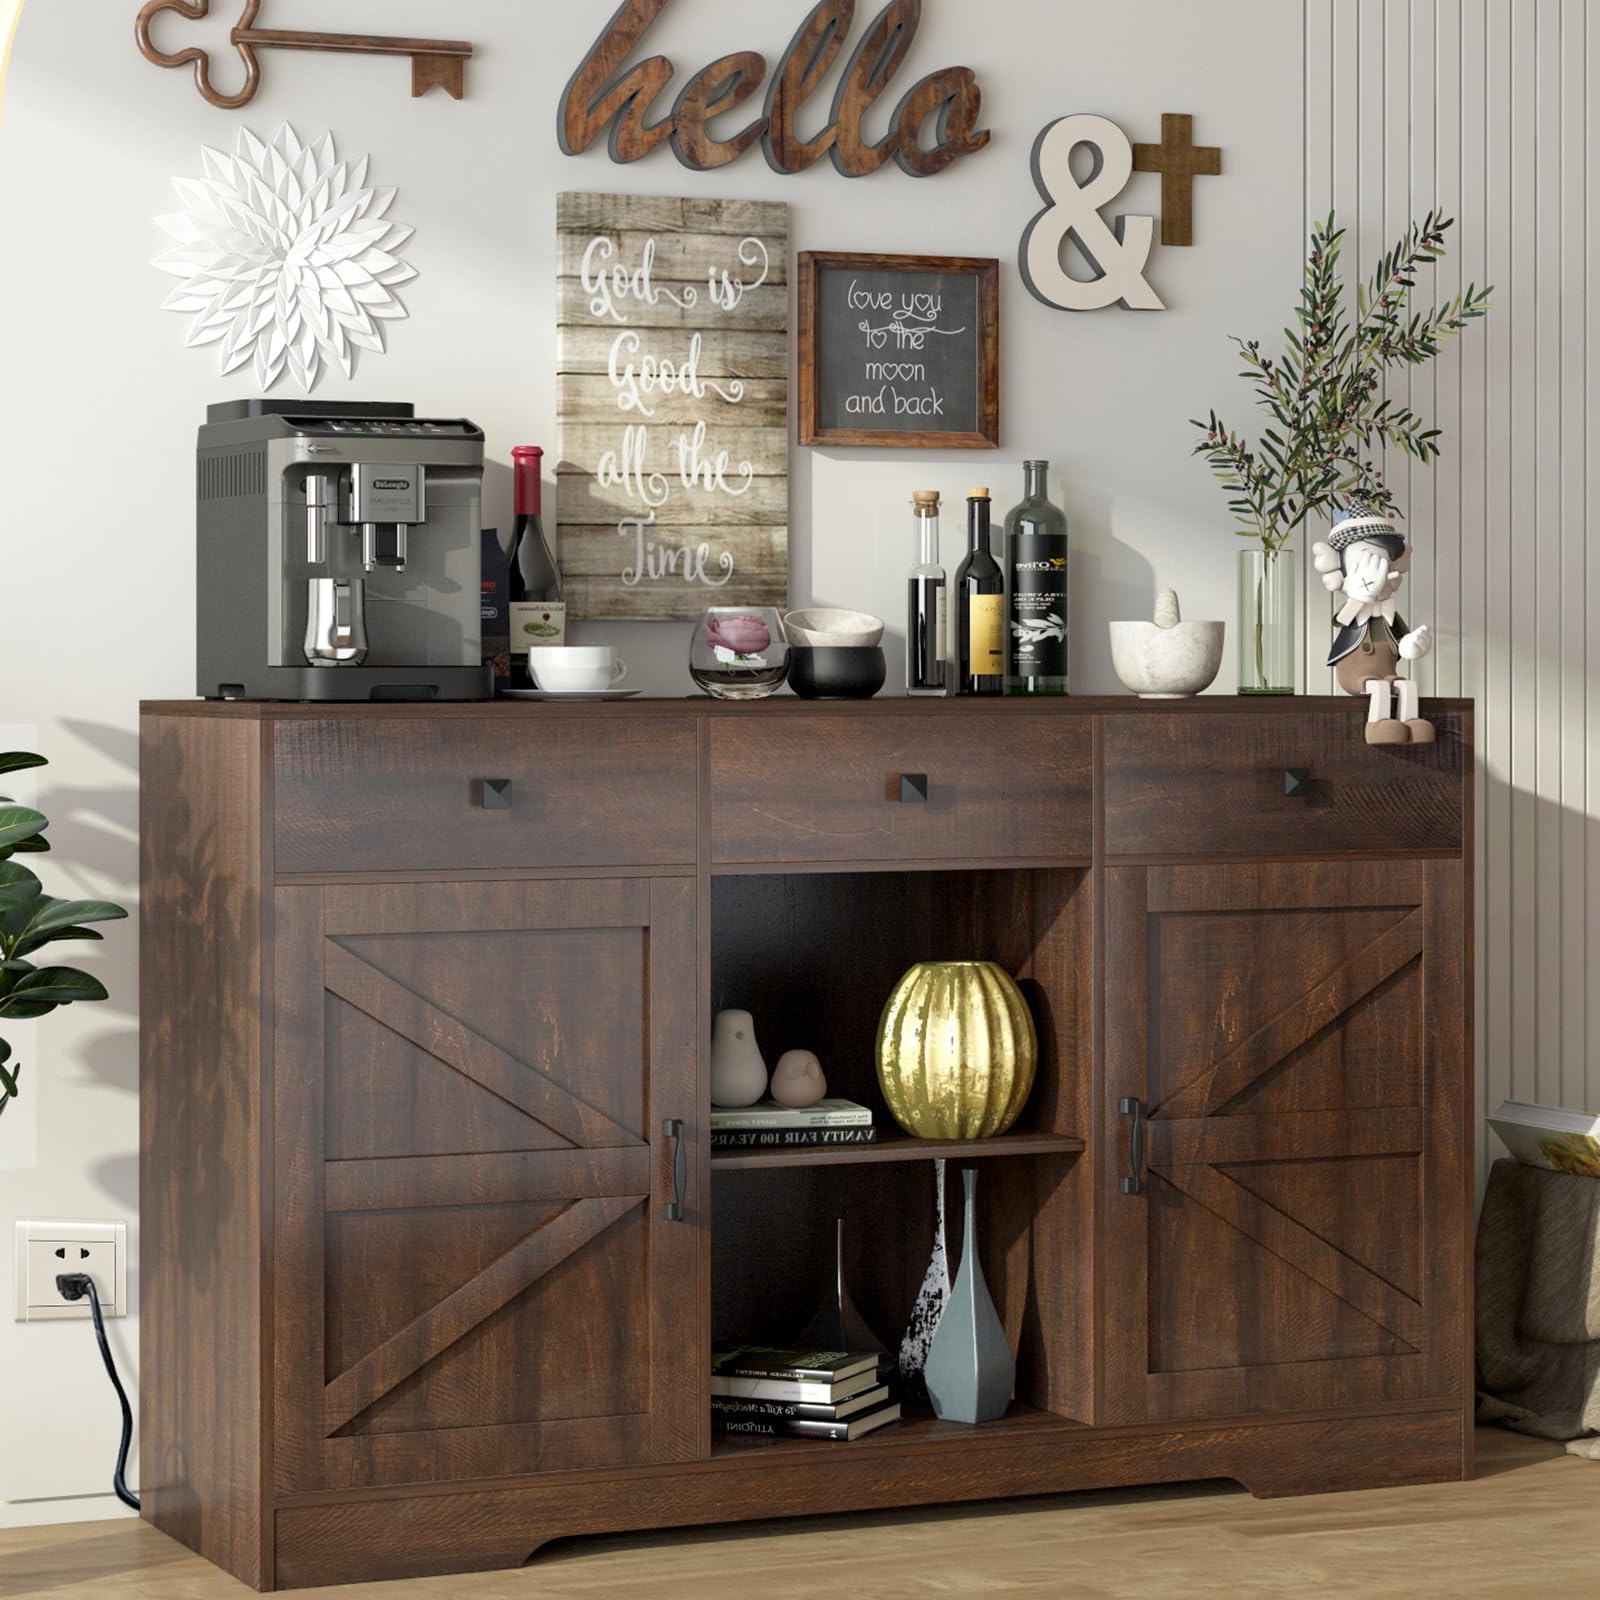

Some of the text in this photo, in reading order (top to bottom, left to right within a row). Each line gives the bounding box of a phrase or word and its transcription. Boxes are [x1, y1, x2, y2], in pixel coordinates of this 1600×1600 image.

[556, 0, 991, 178] hello
[581, 236, 769, 322] God is
[847, 279, 942, 322] love you
[608, 331, 744, 416] Good
[858, 320, 888, 349] to
[865, 362, 925, 382] moon
[845, 385, 944, 415] and back
[597, 419, 753, 507] all the
[617, 508, 734, 586] Time
